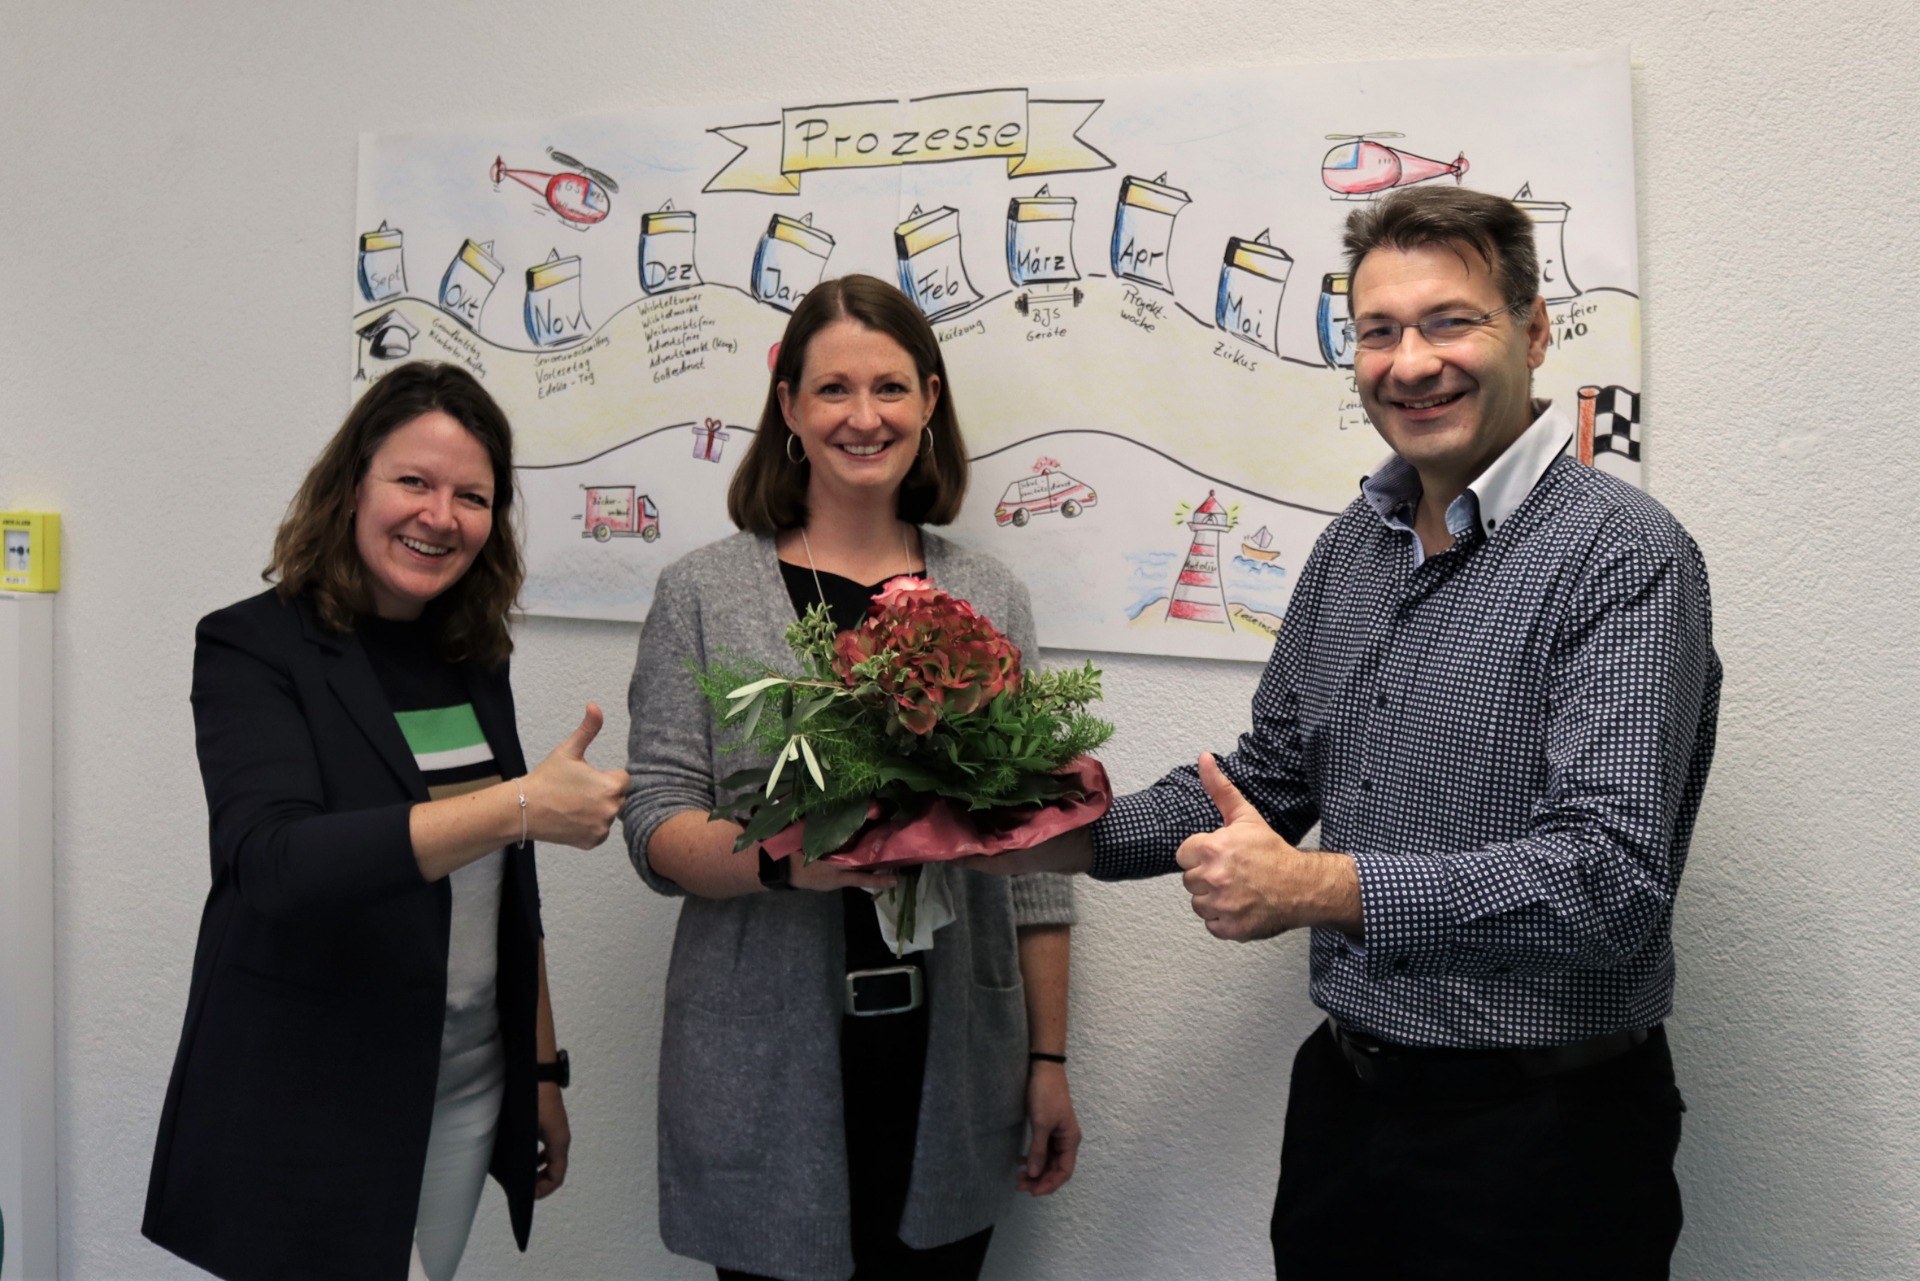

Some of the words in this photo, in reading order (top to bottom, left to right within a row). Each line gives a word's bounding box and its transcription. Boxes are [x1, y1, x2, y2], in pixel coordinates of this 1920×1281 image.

[795, 118, 1021, 158] Prozesse
[1017, 246, 1066, 276] März
[1119, 237, 1164, 272] Apr
[370, 264, 400, 291] Sept
[645, 260, 693, 289] Dez
[917, 266, 959, 305] Feb
[444, 283, 479, 319] Okt
[1032, 308, 1061, 327] BJS
[1225, 291, 1263, 338] Mai
[535, 298, 582, 338] Nov
[1212, 340, 1259, 372] Zirkus
[1234, 608, 1279, 638] Leseinse
